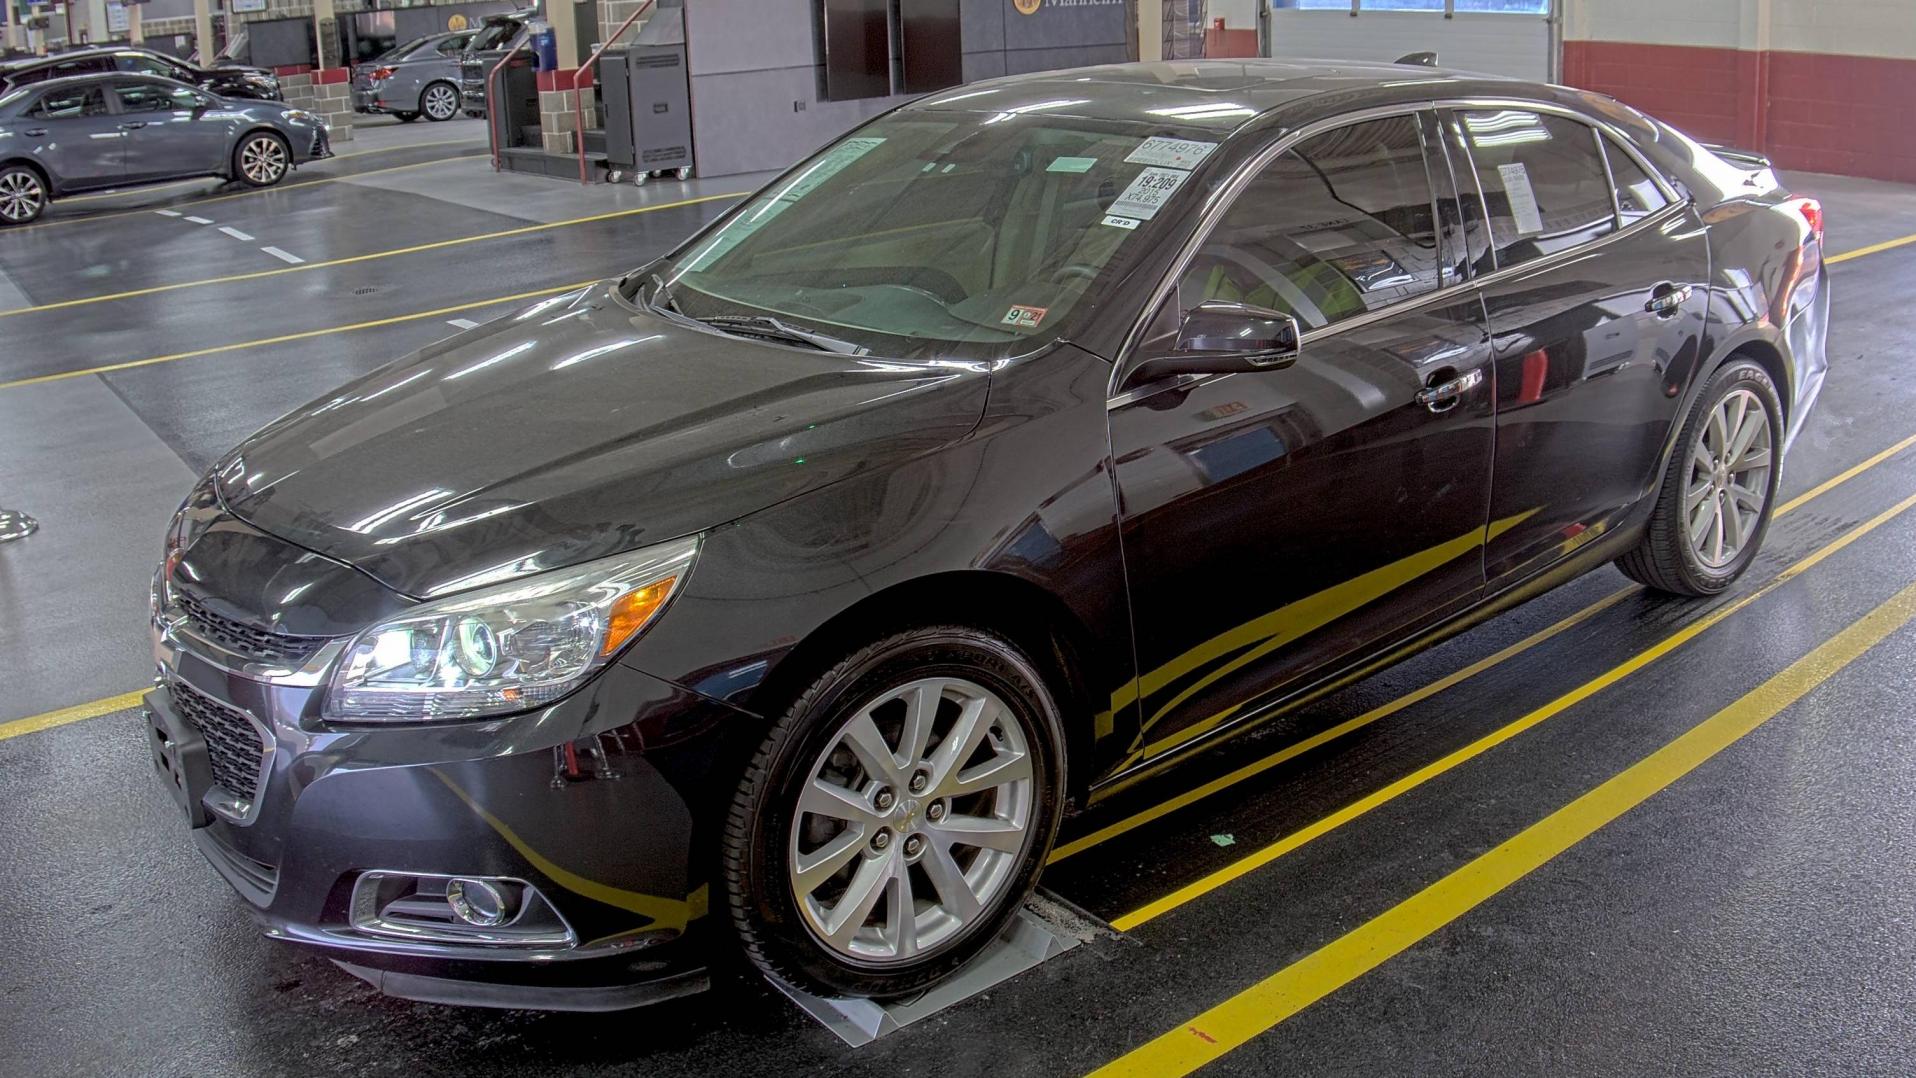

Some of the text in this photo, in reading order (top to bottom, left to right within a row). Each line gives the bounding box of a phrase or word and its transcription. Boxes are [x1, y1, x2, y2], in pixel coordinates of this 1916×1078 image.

[1138, 175, 1177, 190] 19:209
[1008, 309, 1042, 321] 9 21
